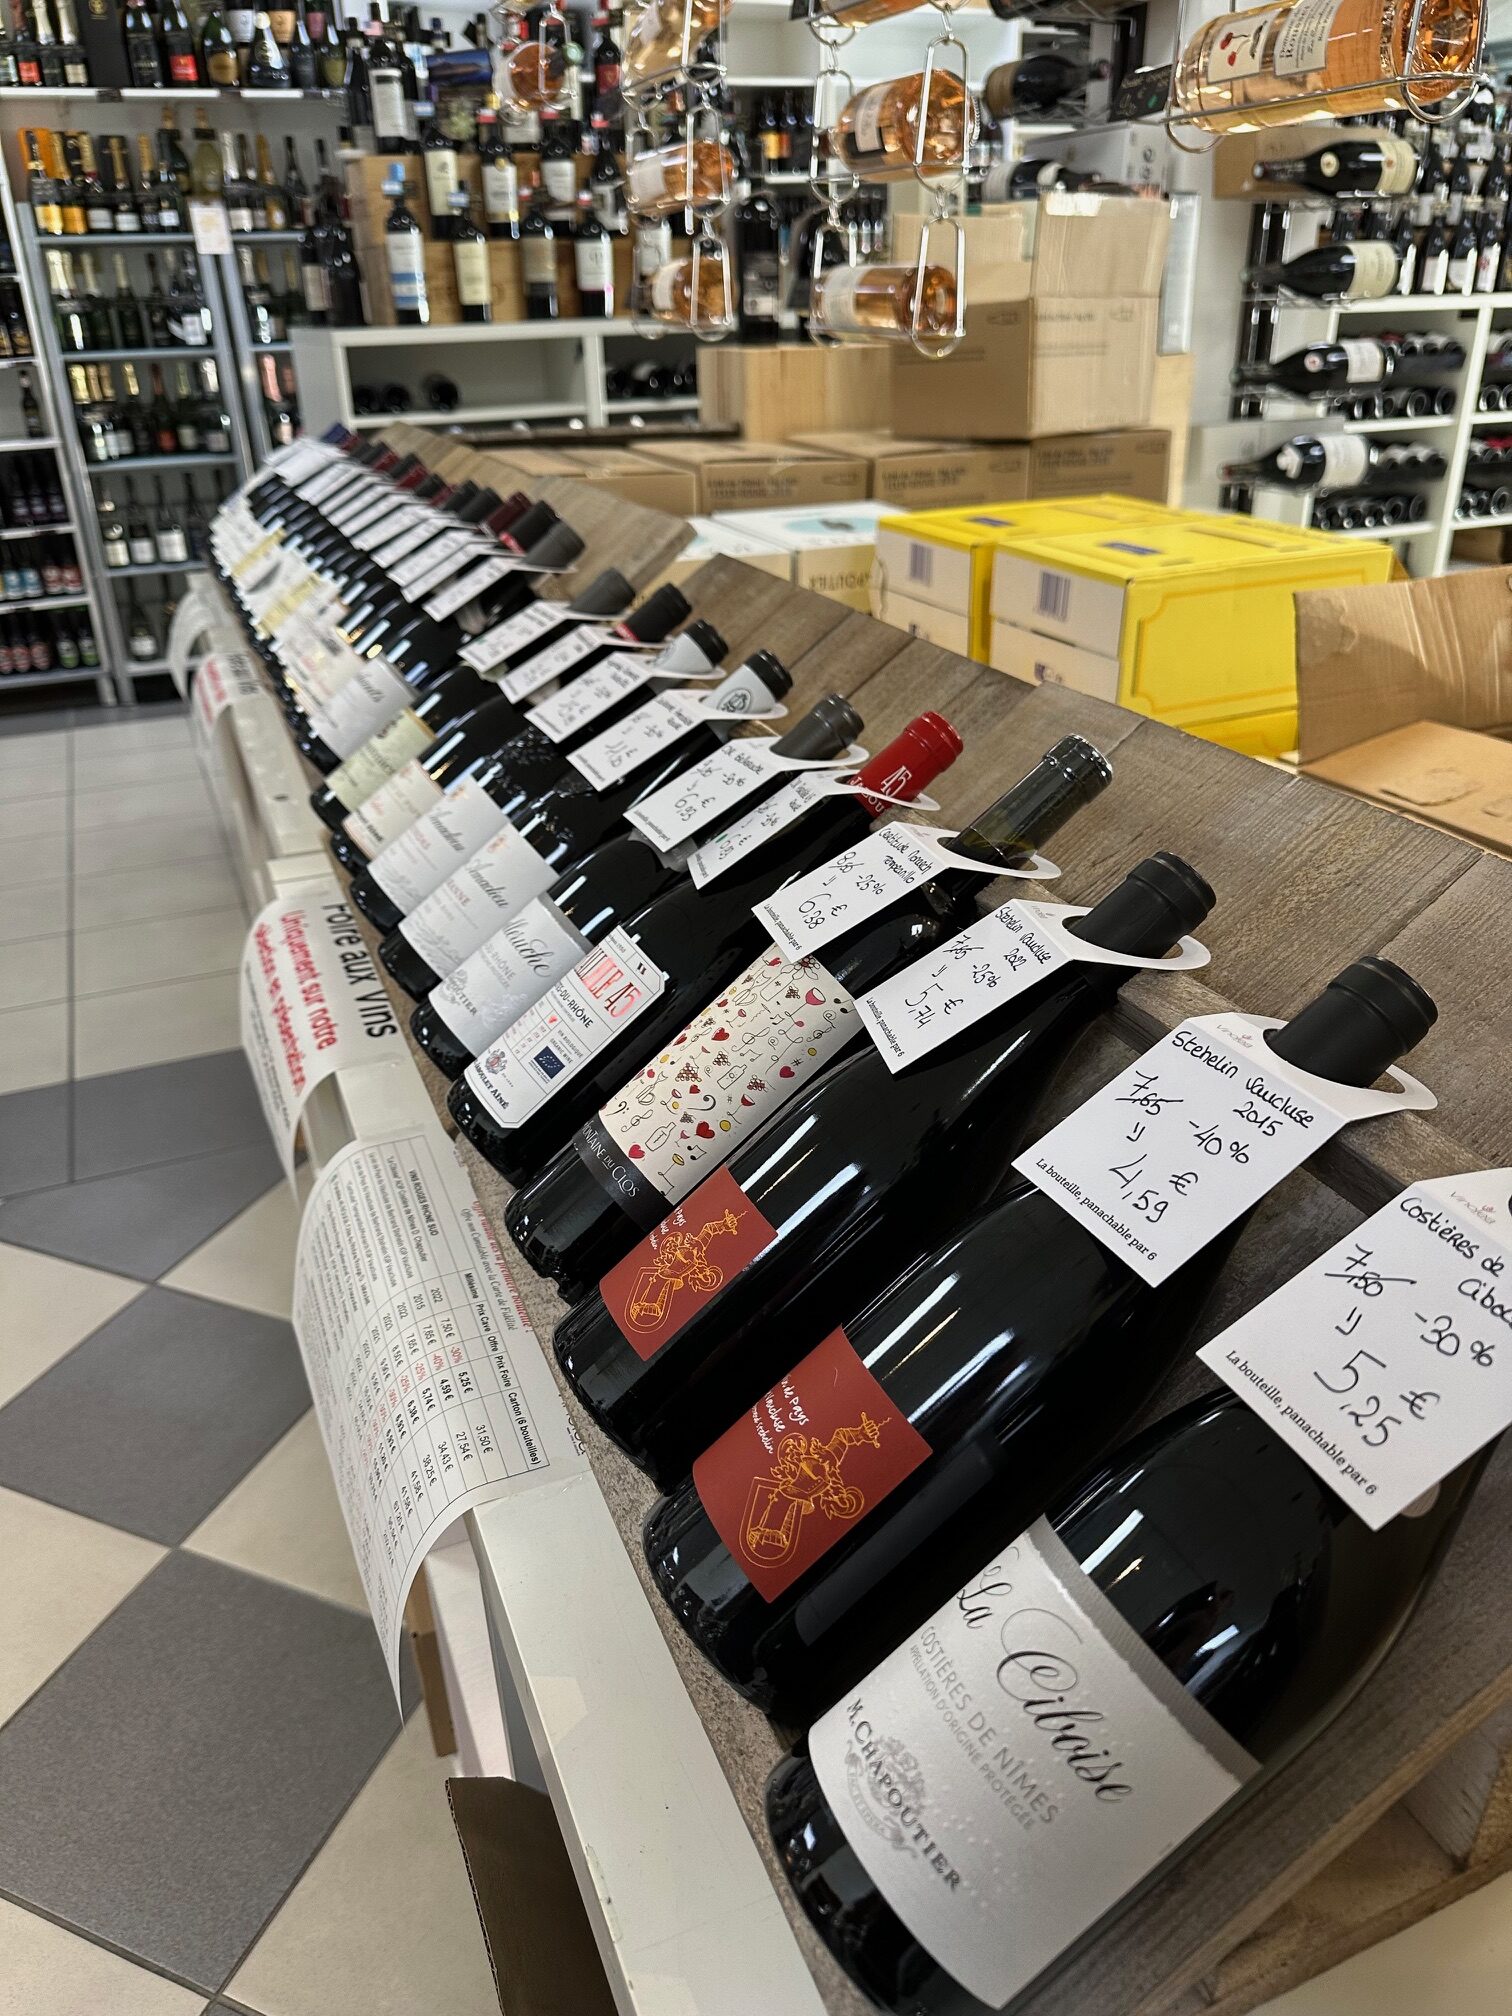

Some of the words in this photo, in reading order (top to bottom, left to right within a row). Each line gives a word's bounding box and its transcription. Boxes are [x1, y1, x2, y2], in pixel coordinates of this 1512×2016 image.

[880, 764, 912, 798] 45
[798, 893, 832, 930] 6,38
[831, 903, 848, 916] €
[339, 950, 378, 985] aux
[302, 983, 326, 1006] sur
[604, 982, 642, 1018] 45
[905, 983, 944, 1029] 5,74
[944, 998, 964, 1014] €
[308, 1007, 338, 1051] notre
[354, 989, 398, 1038] Vins
[1172, 1030, 1239, 1080] Stehelin
[1245, 1077, 1314, 1130] Vaucluse
[1232, 1100, 1283, 1137] 2015
[602, 1155, 616, 1170] DU
[611, 1165, 640, 1198] CLOS
[1109, 1154, 1169, 1224] 4,59
[1169, 1171, 1198, 1197] €
[1035, 1157, 1048, 1171] La
[1045, 1163, 1082, 1202] bouteille,
[1080, 1196, 1133, 1245] panachable
[1128, 1237, 1150, 1257] par
[1148, 1251, 1157, 1262] 6
[1400, 1197, 1480, 1261] Costières
[1481, 1256, 1505, 1278] de
[482, 1259, 492, 1273] avec
[490, 1280, 503, 1298] Carte
[497, 1297, 506, 1306] de
[476, 1304, 484, 1316] Prix
[481, 1316, 491, 1332] Cave
[500, 1306, 518, 1330] Fidélité
[488, 1336, 498, 1352] Offre
[495, 1355, 504, 1369] Prix
[413, 1294, 425, 1310] 2015
[440, 1379, 452, 1395] 4,59
[456, 1431, 470, 1454] 27,54
[431, 1288, 443, 1303] 2022
[459, 1371, 471, 1390] 5,25
[476, 1424, 491, 1446] 31,50
[500, 1369, 511, 1387] Foire
[407, 1400, 418, 1417] 6,38
[509, 1392, 521, 1417] Carton
[789, 1396, 810, 1426] Pays
[1314, 1350, 1402, 1447] 5,25
[1399, 1390, 1441, 1419] €
[412, 1416, 420, 1424] €
[422, 1387, 433, 1405] 5,74
[438, 1441, 452, 1465] 34,43
[445, 1464, 454, 1472] €
[515, 1417, 526, 1425] (6
[1225, 1350, 1240, 1365] La
[1239, 1360, 1283, 1410] bouteille,
[1280, 1404, 1345, 1468] panachable
[1340, 1462, 1368, 1488] par
[1365, 1484, 1377, 1496] 6
[520, 1425, 541, 1465] bouteilles)
[423, 1454, 435, 1479] 38,25
[429, 1478, 437, 1486] €
[416, 1492, 424, 1502] €
[957, 1546, 1020, 1630] La
[996, 1608, 1133, 1803] Ciboise
[909, 1644, 940, 1707] APPELLATION
[934, 1702, 981, 1770] D'ORIGINE
[976, 1763, 1036, 1831] PROTÉGÉE
[919, 1625, 972, 1712] COSTIÈRES
[967, 1711, 994, 1749] DE
[995, 1747, 1059, 1825] NÎMES
